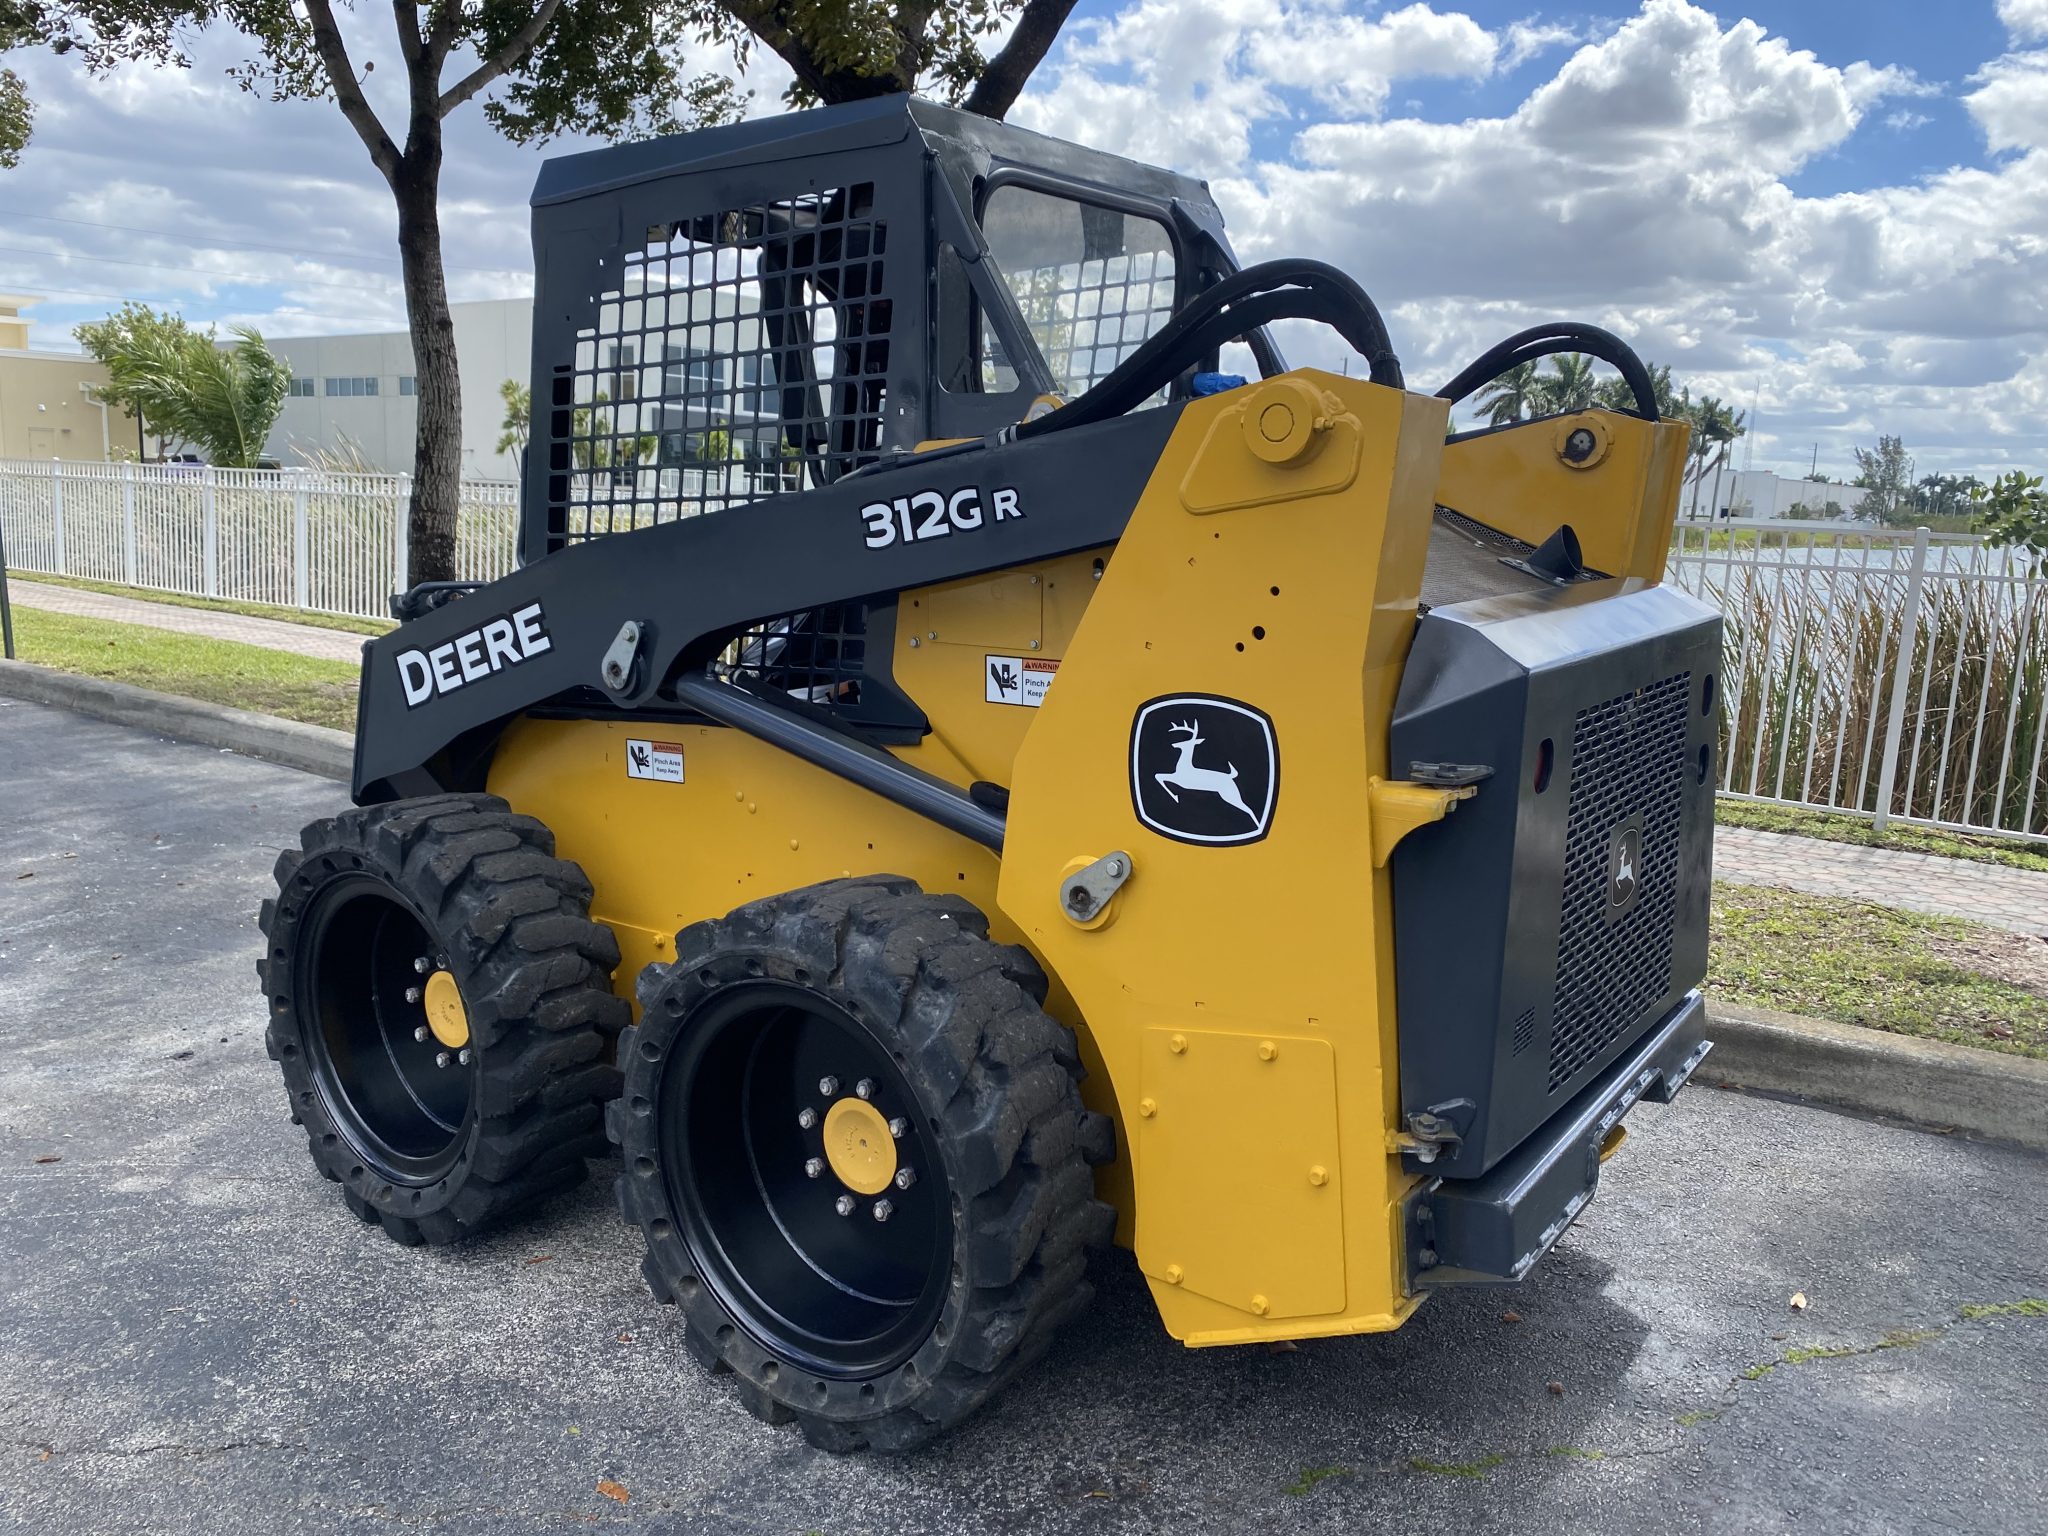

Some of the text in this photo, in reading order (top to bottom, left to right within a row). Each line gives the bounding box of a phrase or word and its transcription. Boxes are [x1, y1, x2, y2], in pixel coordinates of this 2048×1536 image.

[861, 488, 1021, 548] 312G R
[396, 603, 550, 706] DEERE
[1031, 662, 1059, 670] WARNIN
[1025, 678, 1045, 687] Pinch
[1027, 689, 1043, 697] Keep
[658, 744, 681, 752] WARNING
